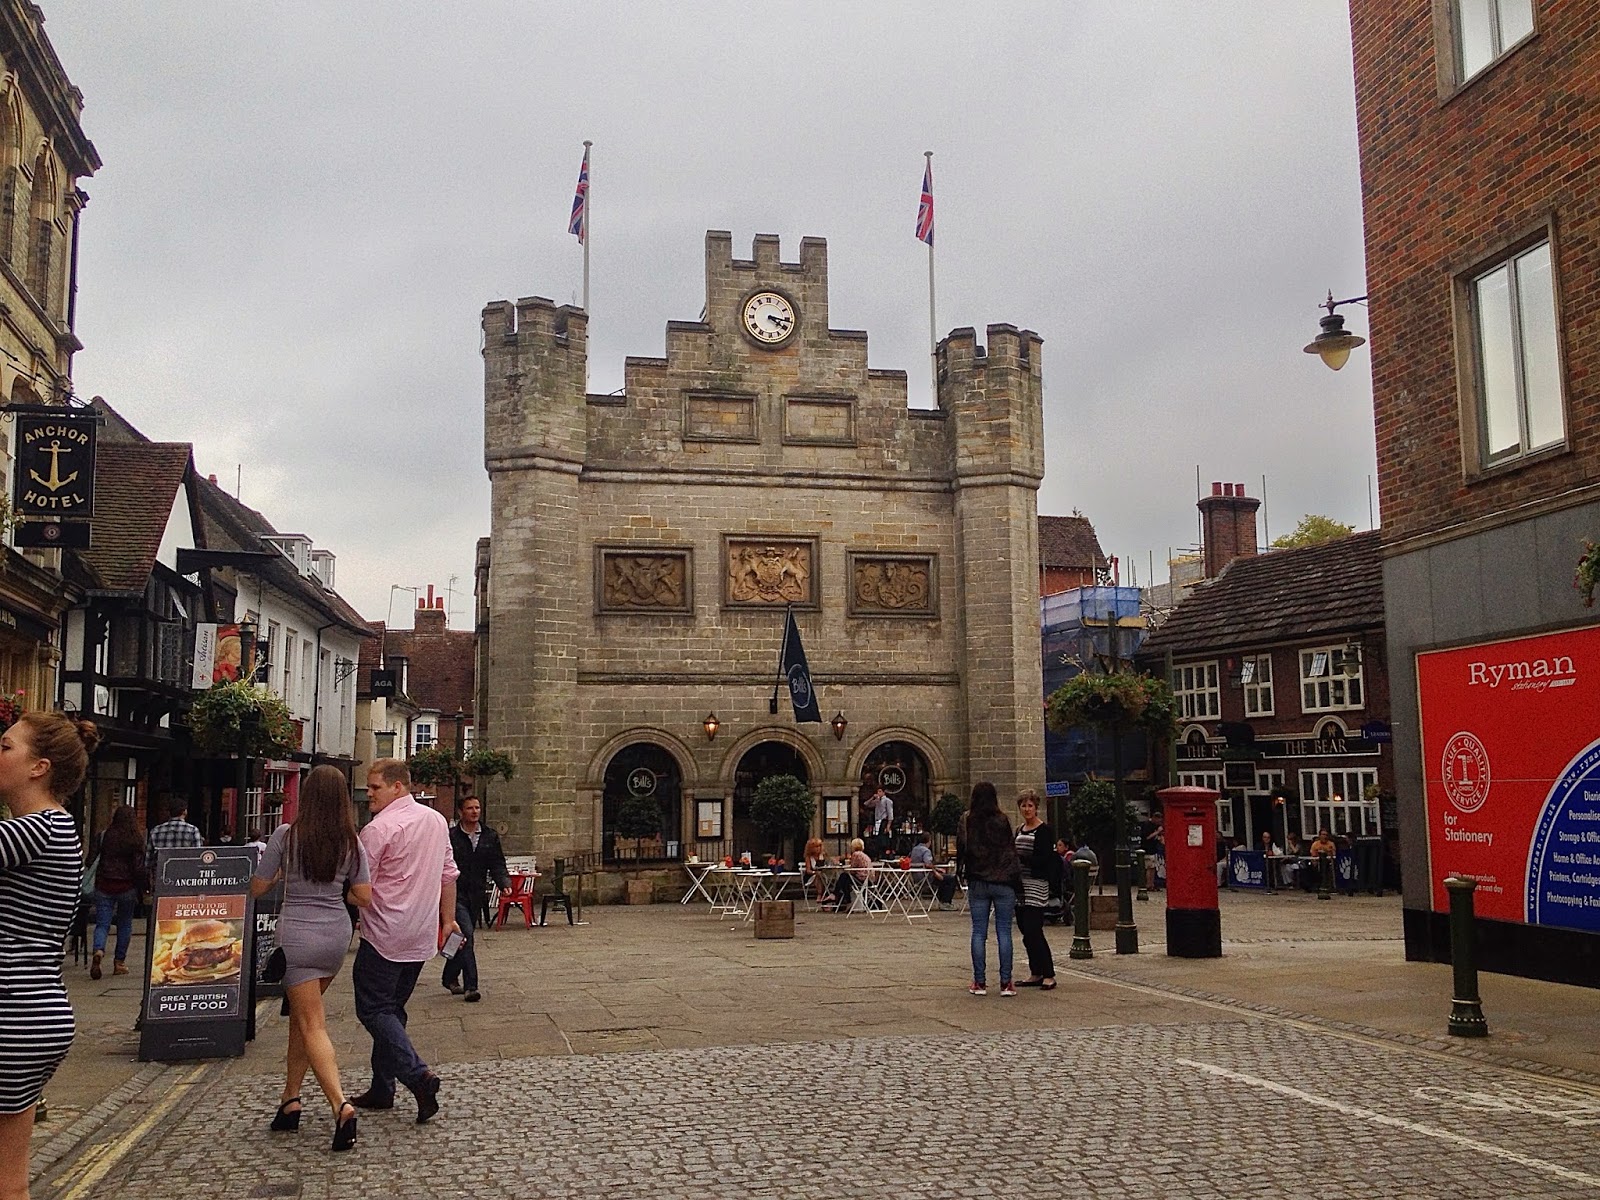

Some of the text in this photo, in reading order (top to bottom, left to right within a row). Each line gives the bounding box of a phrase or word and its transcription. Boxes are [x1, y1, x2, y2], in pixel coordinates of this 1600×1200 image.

[24, 425, 89, 445] ANCHOR
[23, 490, 85, 508] HOTEL
[1467, 656, 1576, 688] Ryman
[1187, 745, 1206, 758] THE
[1285, 738, 1348, 755] THE BEAR
[1446, 745, 1458, 780] VALUE
[1463, 738, 1486, 781] QUALITY
[633, 775, 652, 788] Bill's
[883, 772, 901, 786] Bill's
[1451, 789, 1482, 806] SERVICE
[1444, 811, 1458, 825] for
[1444, 827, 1493, 847] Stationery
[1559, 830, 1580, 844] Storage
[1581, 831, 1586, 842] &
[1529, 803, 1556, 910] www.ryman.co.uk
[1553, 851, 1569, 863] Home
[1570, 853, 1575, 864] &
[1575, 853, 1592, 864] Office
[199, 870, 217, 878] THE
[1475, 874, 1497, 883] products
[1549, 870, 1571, 884] Printers,
[174, 877, 239, 887] ANCHOR HOTEL
[1493, 884, 1504, 895] day
[1546, 891, 1583, 908] Photocopying
[1583, 895, 1589, 906] &
[175, 908, 228, 917] SERVING
[160, 993, 228, 1002] GREAT BRITISH
[159, 1001, 228, 1012] PUB FOOD
